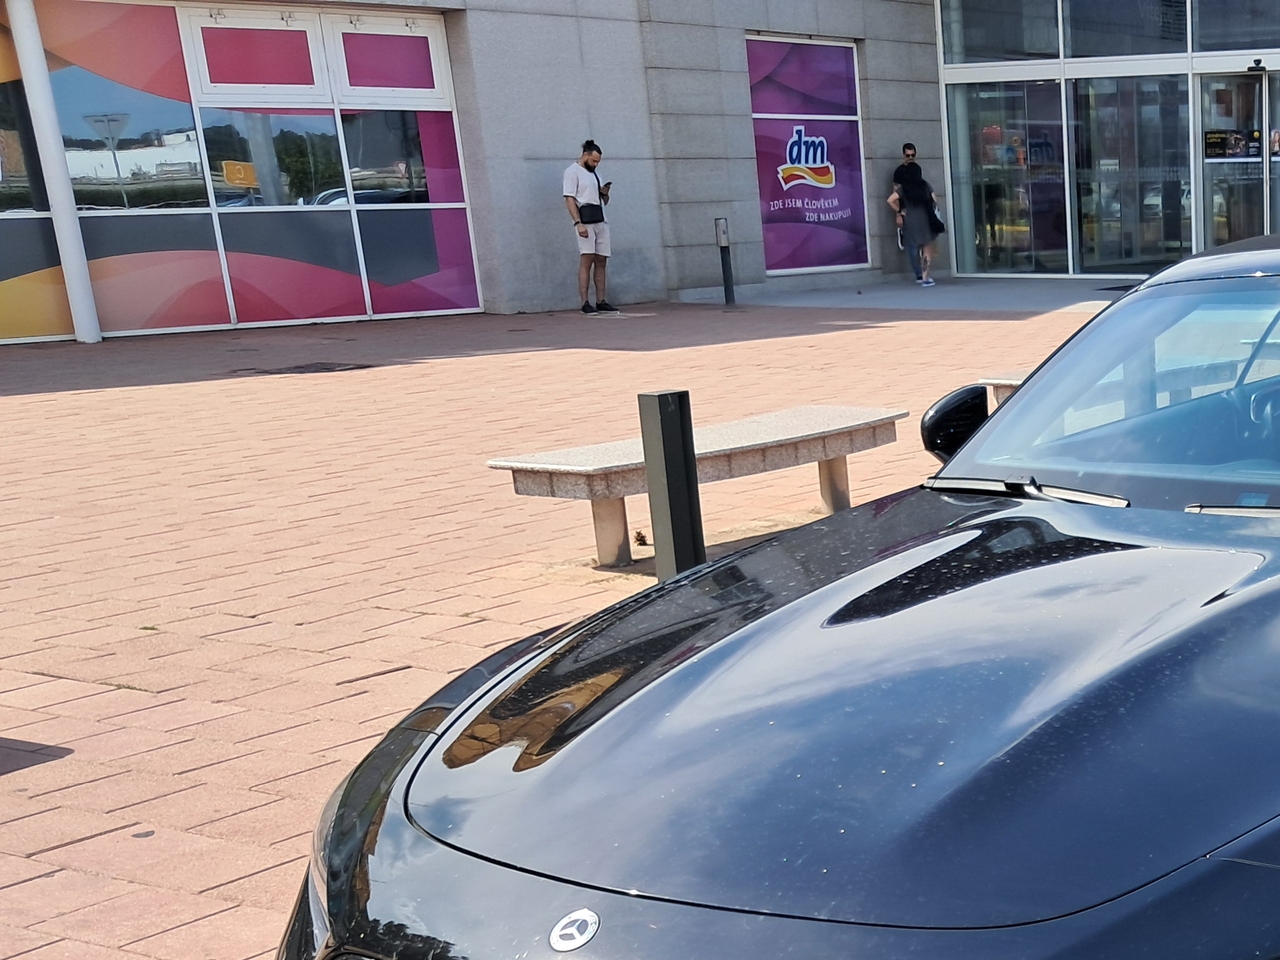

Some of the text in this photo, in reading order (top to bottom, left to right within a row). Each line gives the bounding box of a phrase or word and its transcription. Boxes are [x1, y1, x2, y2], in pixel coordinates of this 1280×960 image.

[788, 129, 825, 165] dm
[770, 197, 839, 211] ZDE JSEM ČLOVĚKEM
[805, 211, 819, 222] ZDE
